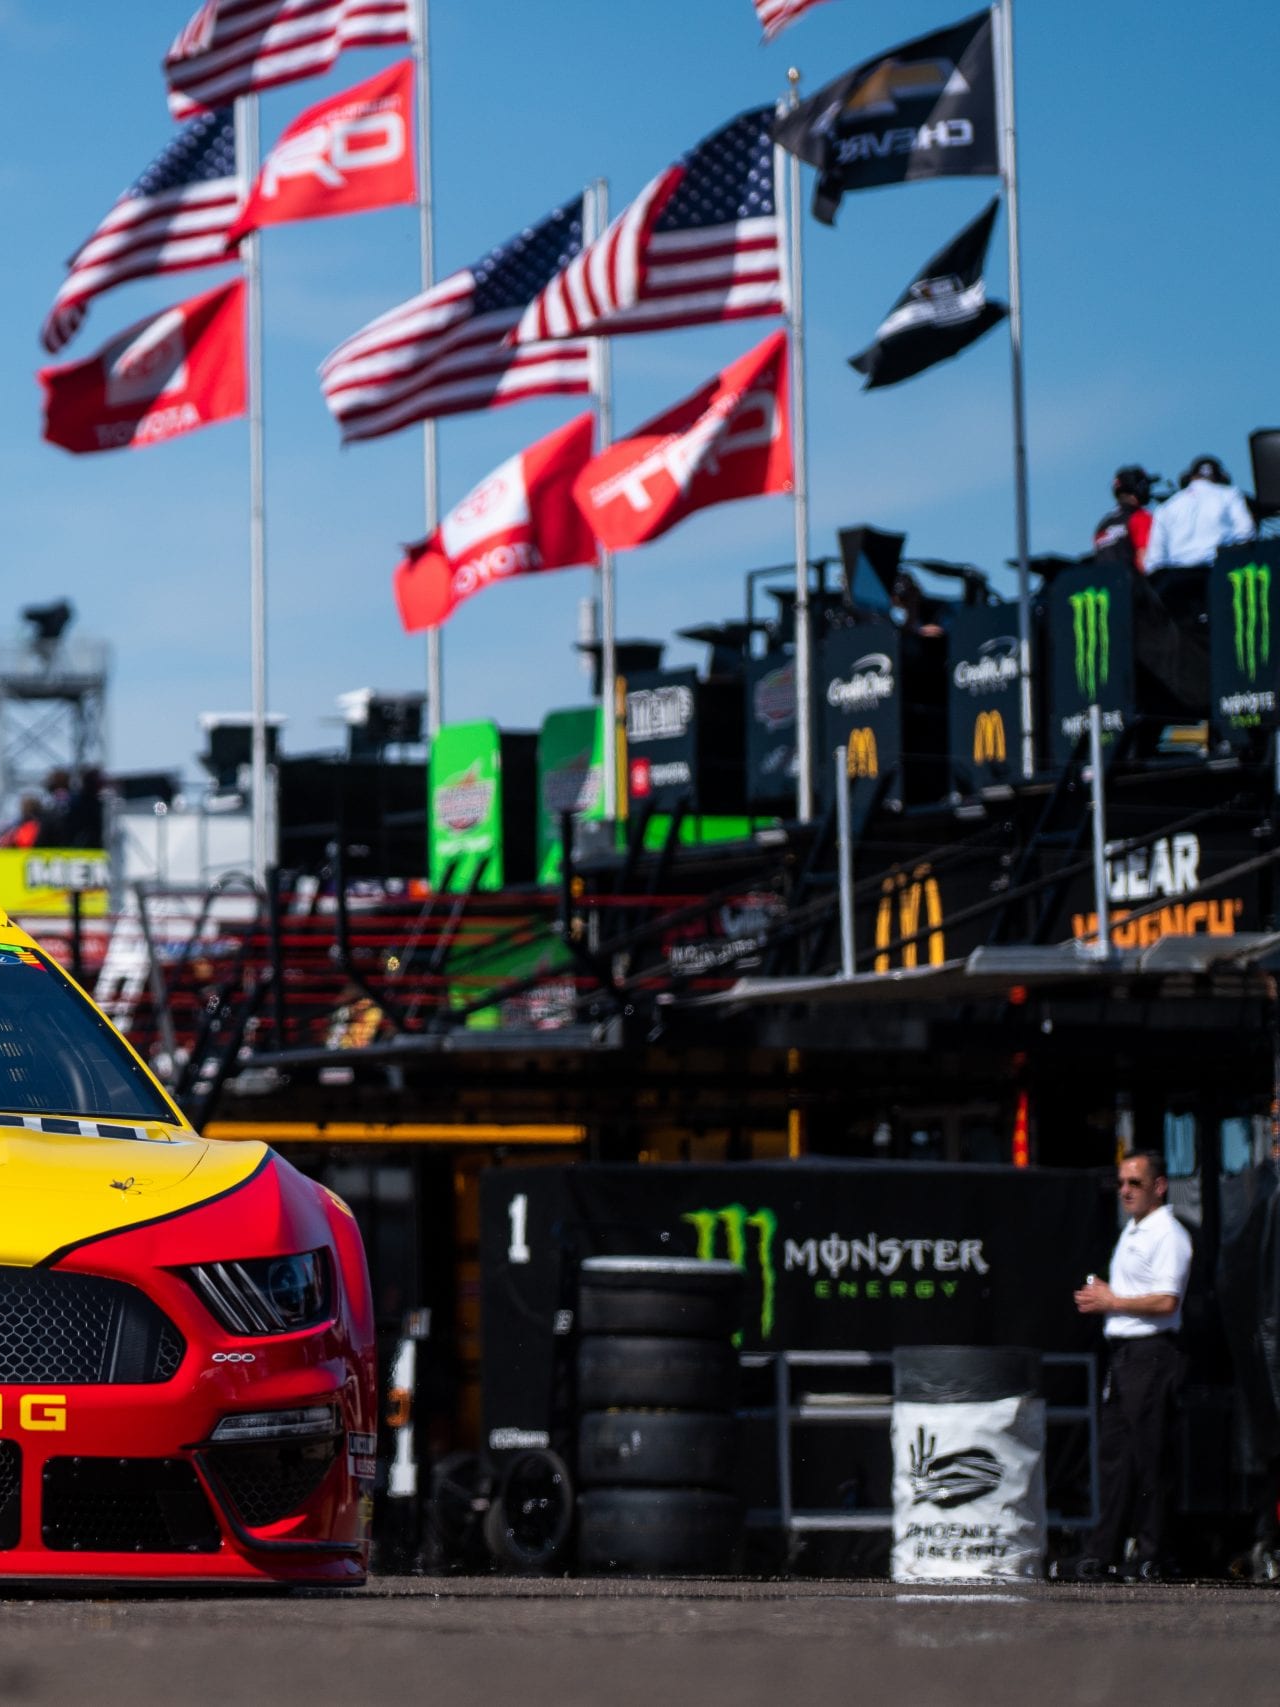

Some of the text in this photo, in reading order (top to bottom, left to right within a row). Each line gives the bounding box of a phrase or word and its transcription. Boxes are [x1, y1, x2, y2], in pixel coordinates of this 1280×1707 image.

[508, 1193, 530, 1263] 1
[784, 1232, 989, 1279] MONSTER
[815, 1280, 958, 1299] ENERGY
